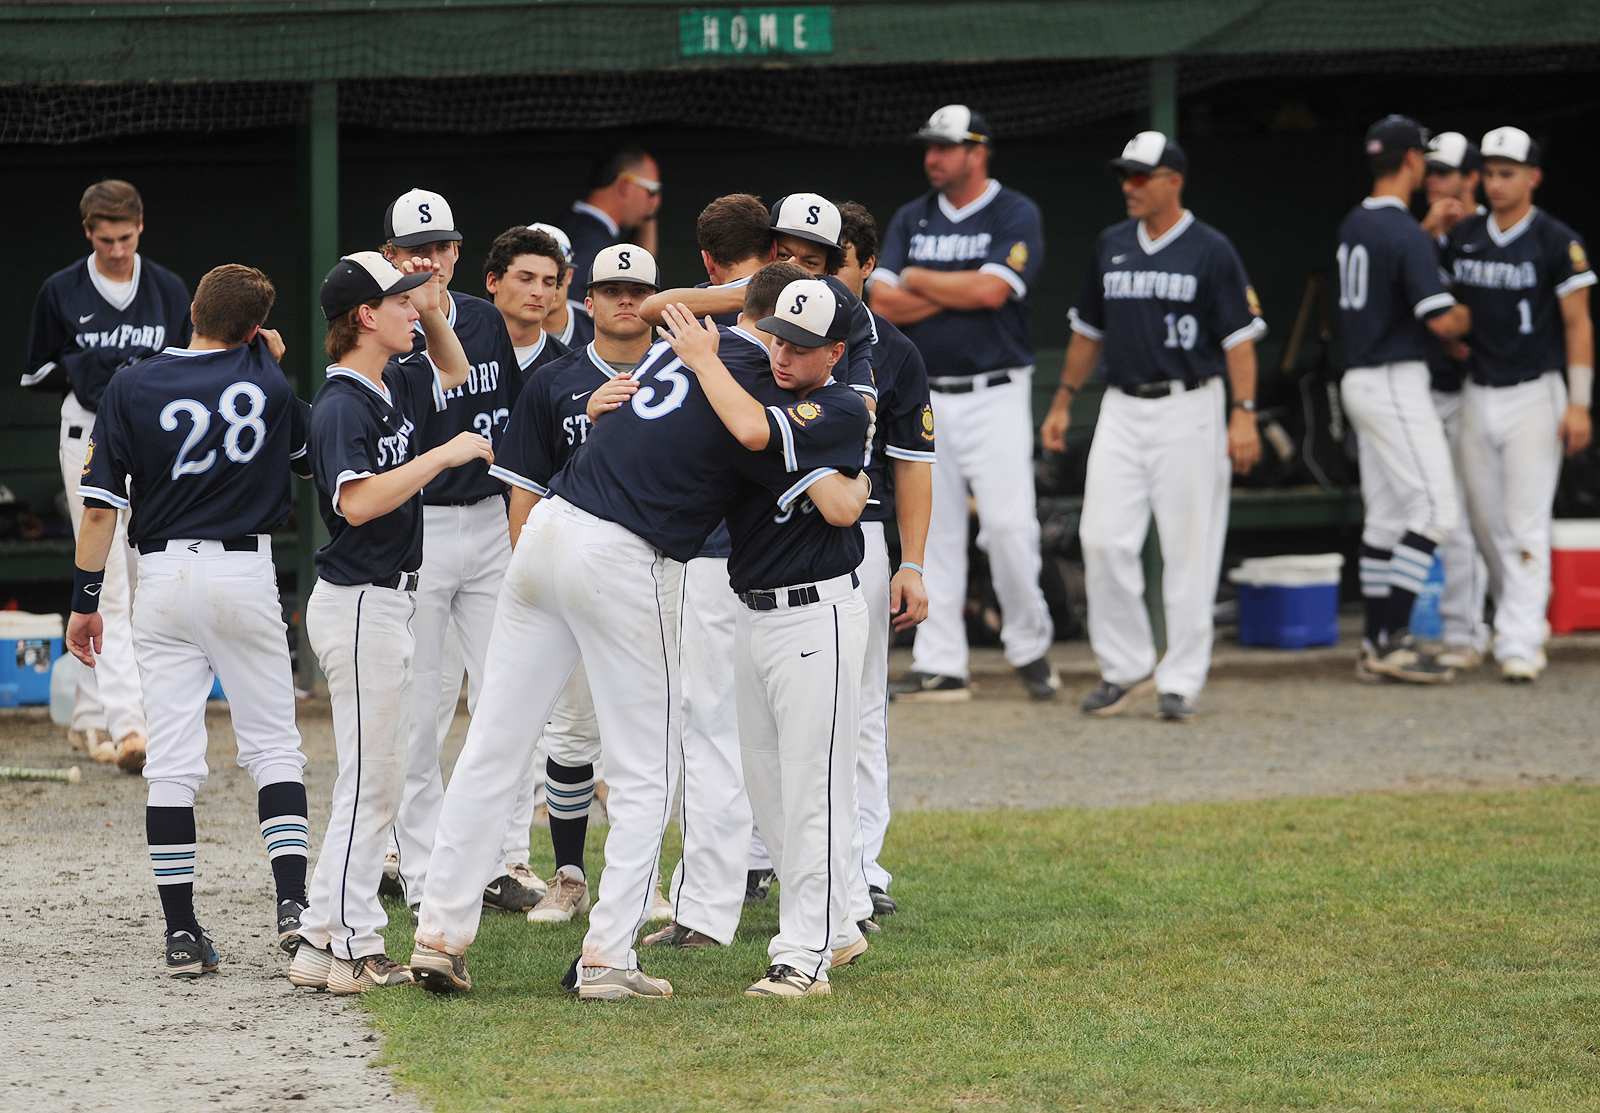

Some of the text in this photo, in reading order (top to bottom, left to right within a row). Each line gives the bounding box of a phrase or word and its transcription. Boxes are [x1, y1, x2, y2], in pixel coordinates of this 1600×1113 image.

[703, 13, 808, 52] HOME
[418, 203, 432, 224] S
[805, 205, 821, 226] S
[617, 251, 631, 271] S
[1337, 242, 1369, 311] 10
[1103, 271, 1198, 302] STAMFORD
[789, 294, 809, 316] S
[1517, 298, 1533, 334] 1
[1164, 313, 1198, 350] 19
[159, 381, 268, 480] 28
